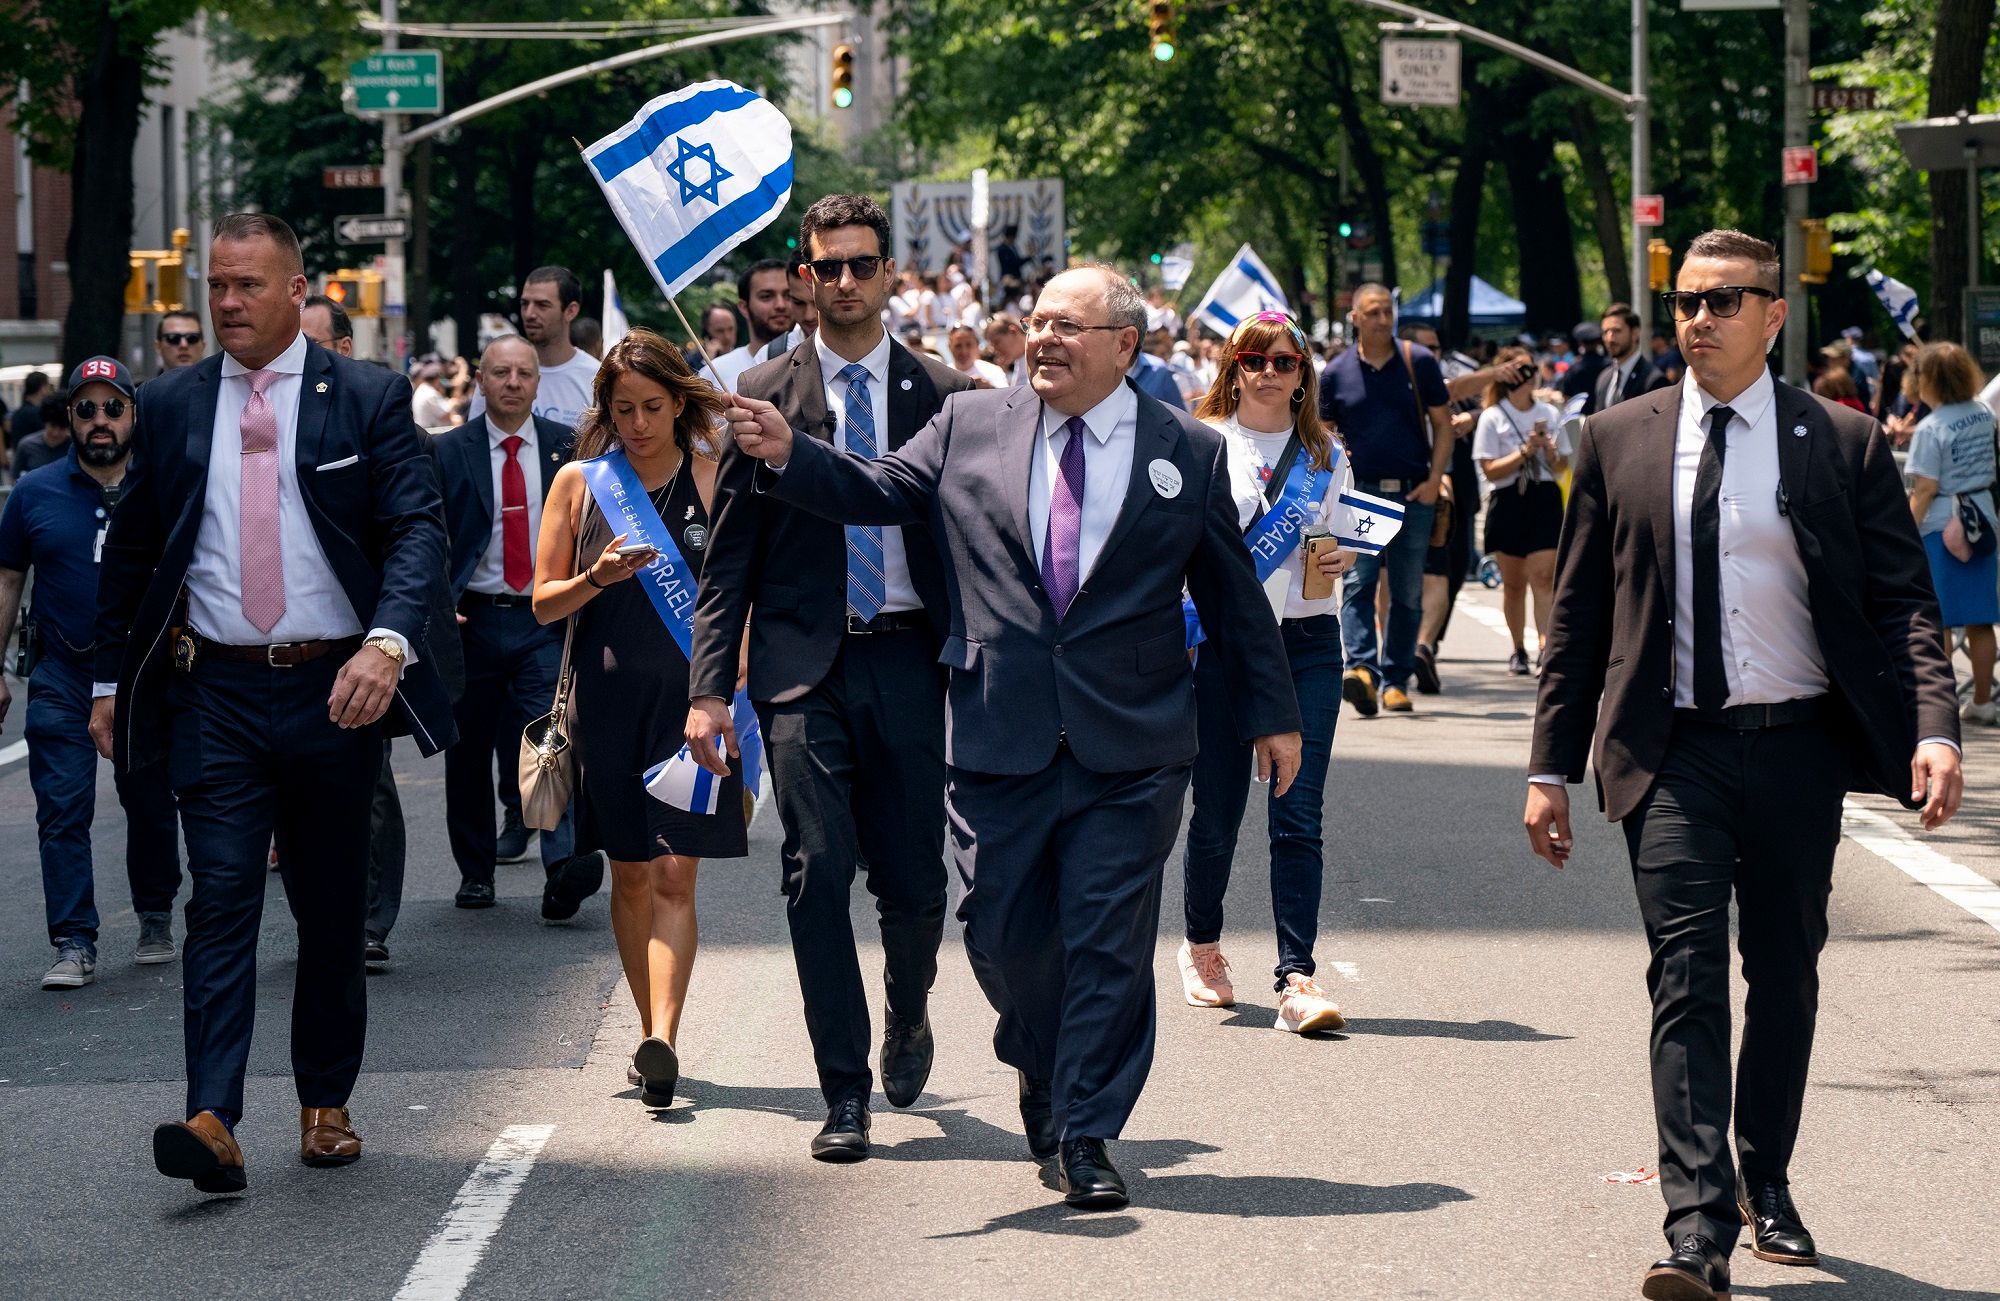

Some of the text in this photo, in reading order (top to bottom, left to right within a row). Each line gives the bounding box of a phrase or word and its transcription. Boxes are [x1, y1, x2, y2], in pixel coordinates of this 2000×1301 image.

[87, 361, 110, 375] 35
[1250, 501, 1307, 560] ISRAEL
[647, 547, 690, 619] SRAEL
